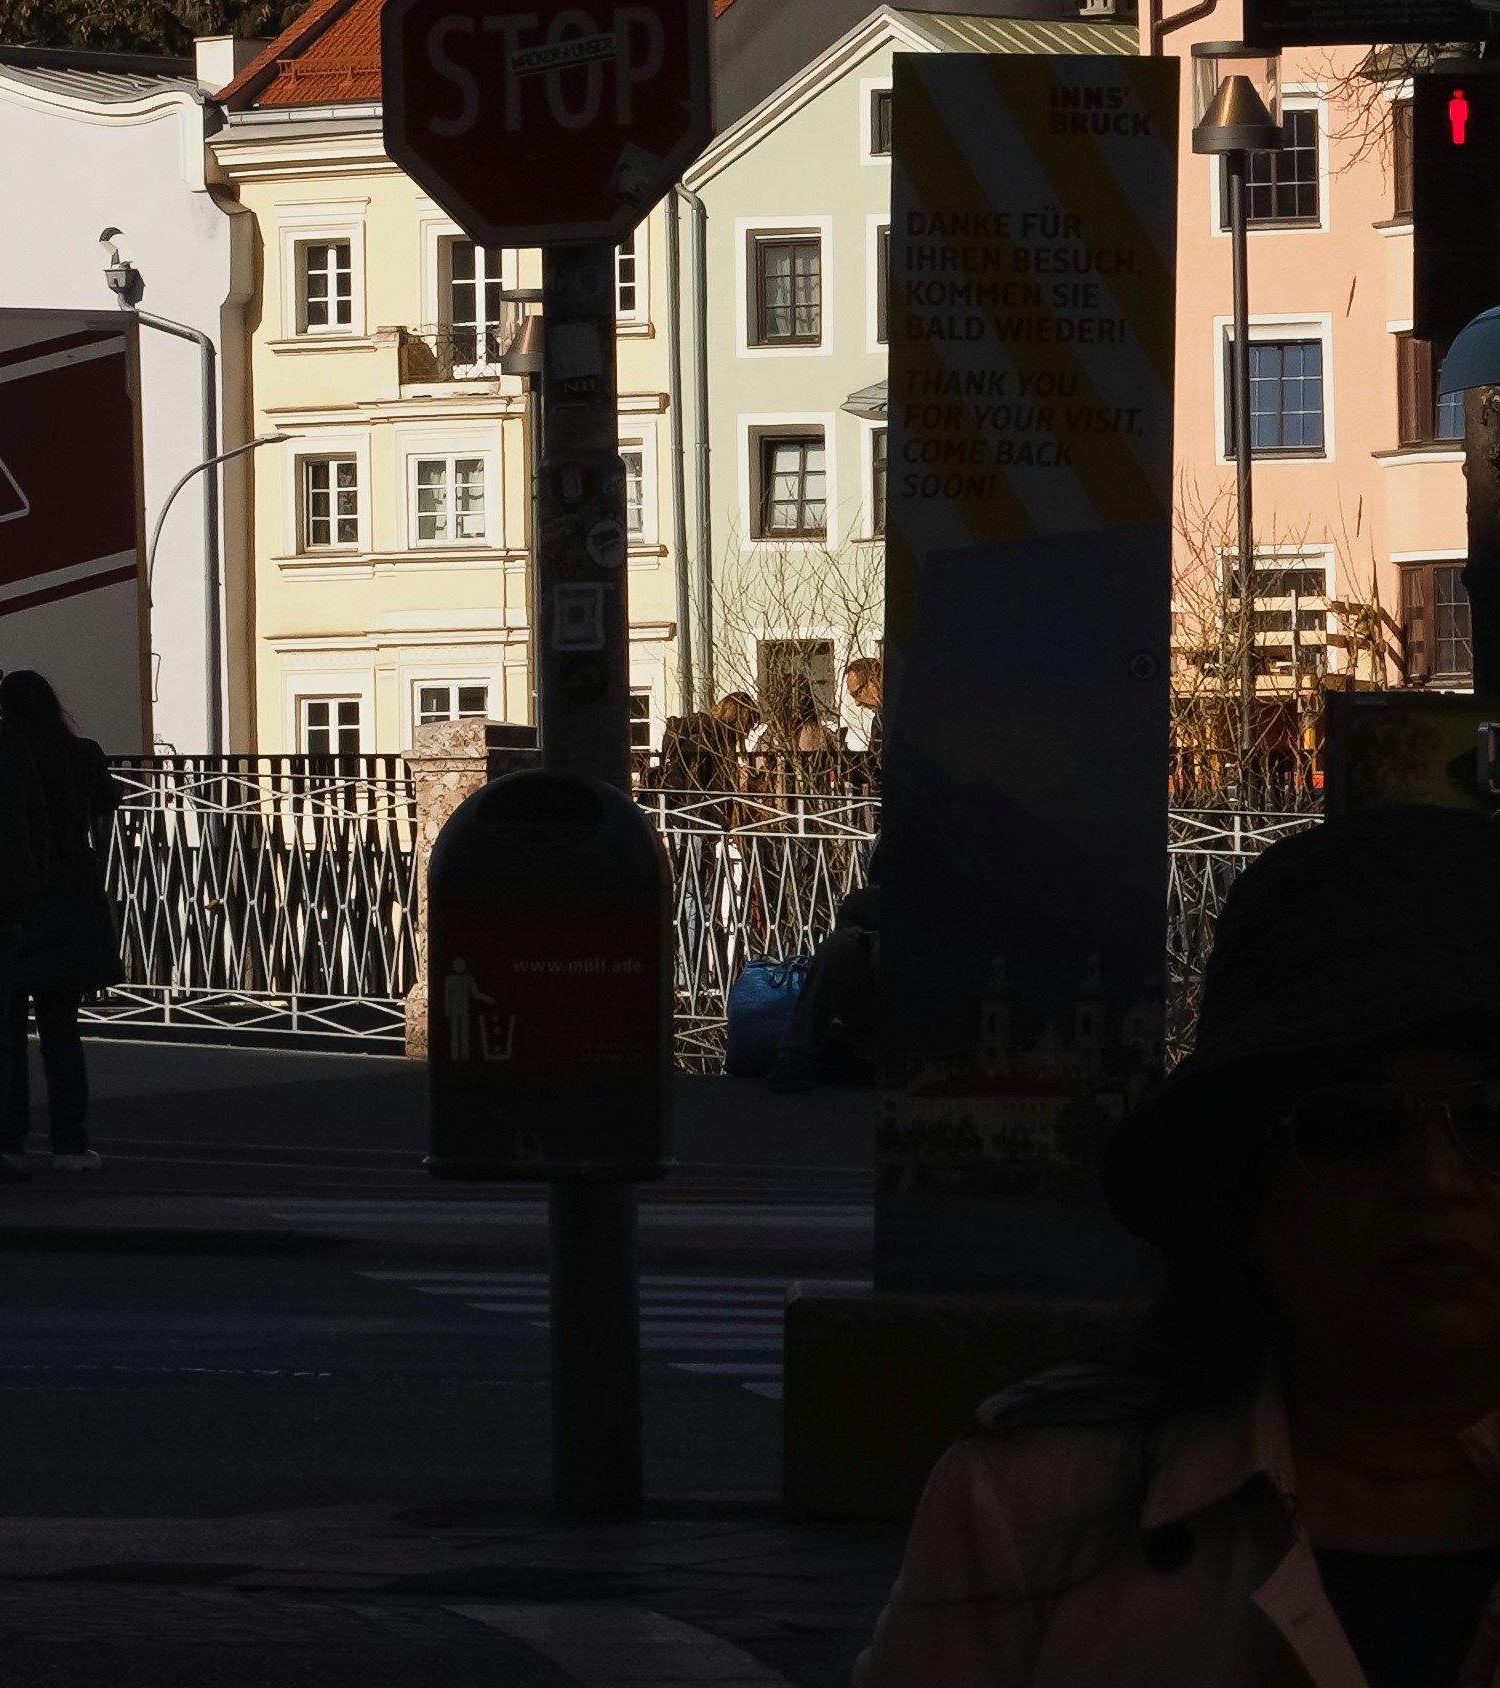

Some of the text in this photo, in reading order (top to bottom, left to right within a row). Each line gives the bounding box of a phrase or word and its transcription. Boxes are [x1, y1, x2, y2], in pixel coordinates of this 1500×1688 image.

[427, 6, 665, 137] STOP
[1049, 113, 1151, 136] BRUCK
[905, 206, 1082, 239] DANKE FÜR
[905, 246, 1143, 277] IHREN BESUCH,
[905, 280, 1099, 310] KOMMEN SIE
[904, 314, 1126, 343] BALD WIEDER!
[904, 369, 1079, 397] THANK YOU
[903, 403, 1144, 438] FOR YOUR VISIT,
[902, 438, 1076, 467] COME BACK
[900, 473, 997, 500] SOON!
[513, 956, 644, 974] www.müll.ade
